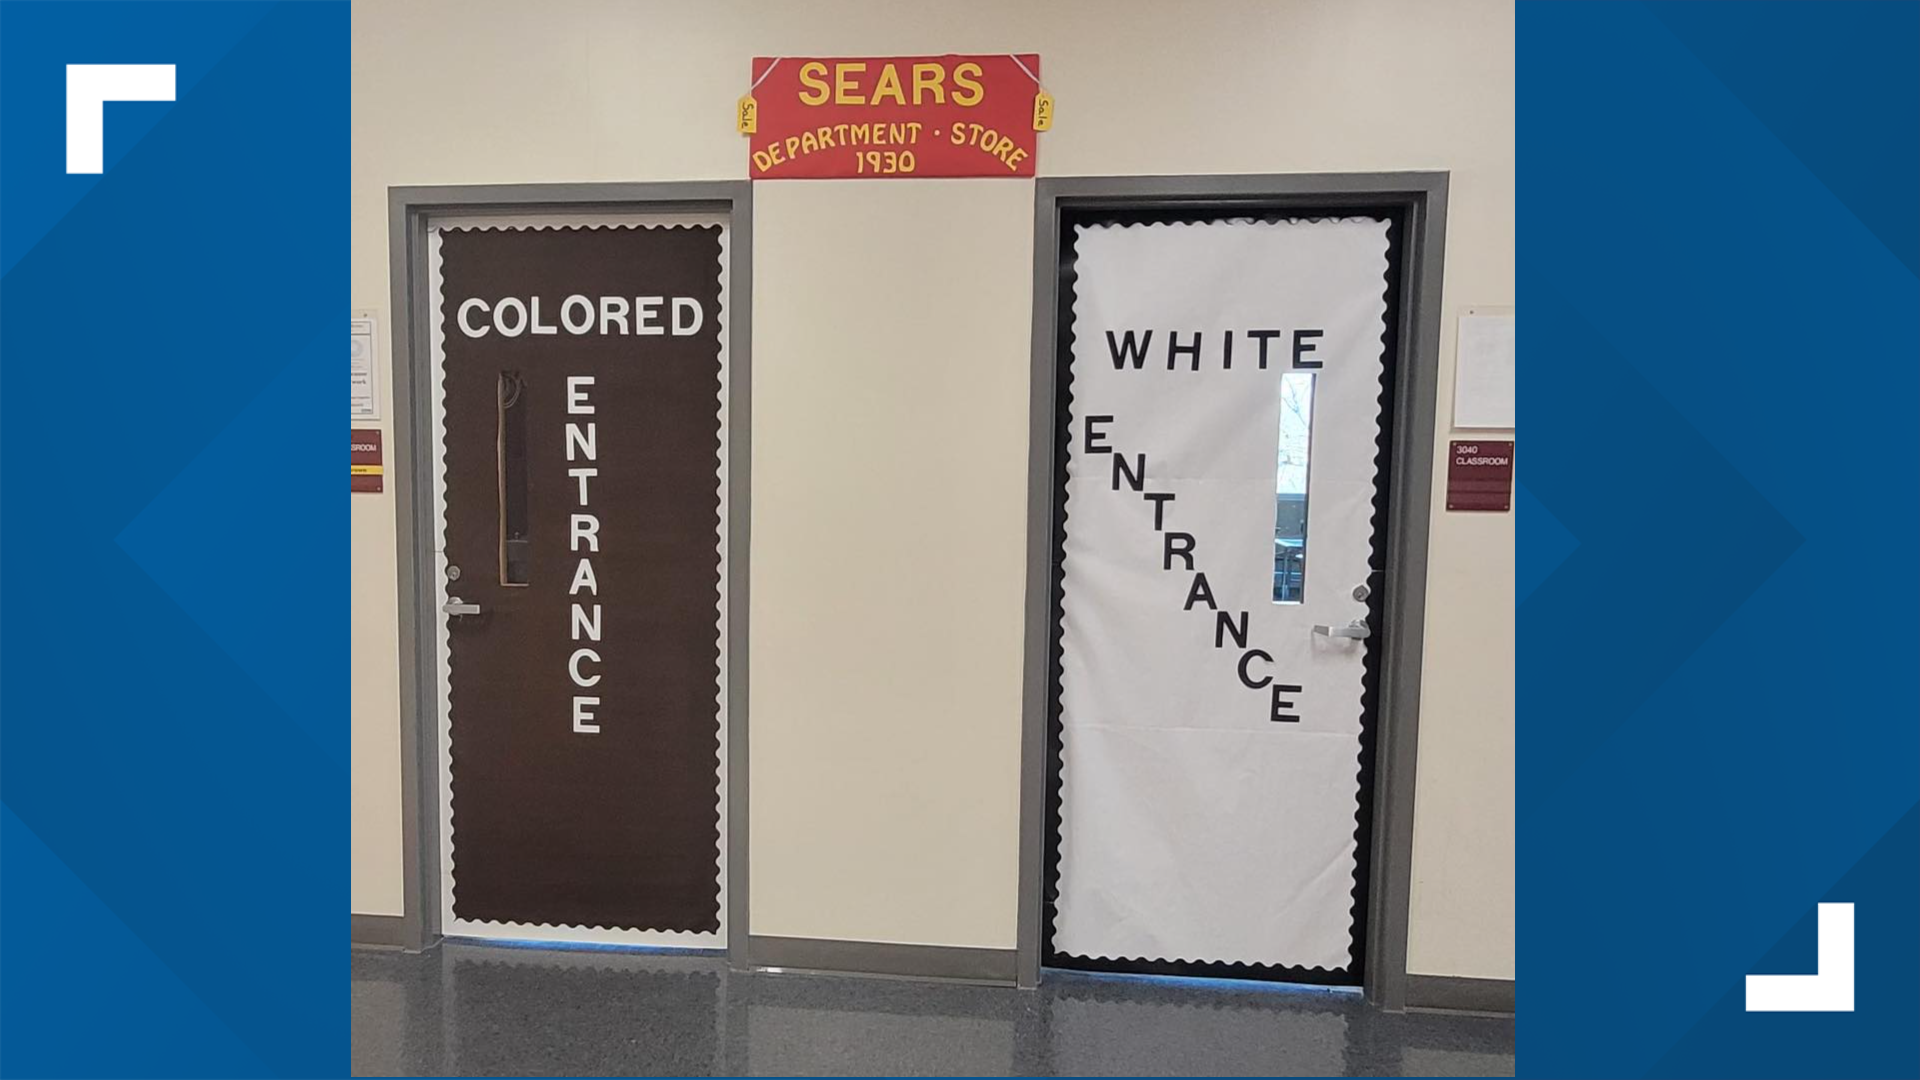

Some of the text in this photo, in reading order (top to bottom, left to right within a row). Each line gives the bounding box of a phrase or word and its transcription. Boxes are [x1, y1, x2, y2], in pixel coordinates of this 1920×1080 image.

[799, 62, 984, 106] SEARS
[741, 102, 754, 129] Sale
[1038, 99, 1049, 127] Sale
[752, 122, 1029, 173] DEPARTMENT STORE
[856, 151, 915, 174] 1930
[458, 295, 704, 338] COLORED
[1106, 329, 1324, 371] WHITE
[1456, 446, 1478, 454] 3040
[1456, 457, 1508, 465] CLASSROOM
[566, 377, 602, 734] ENTRANCE
[1085, 416, 1302, 723] ENTRANCE
